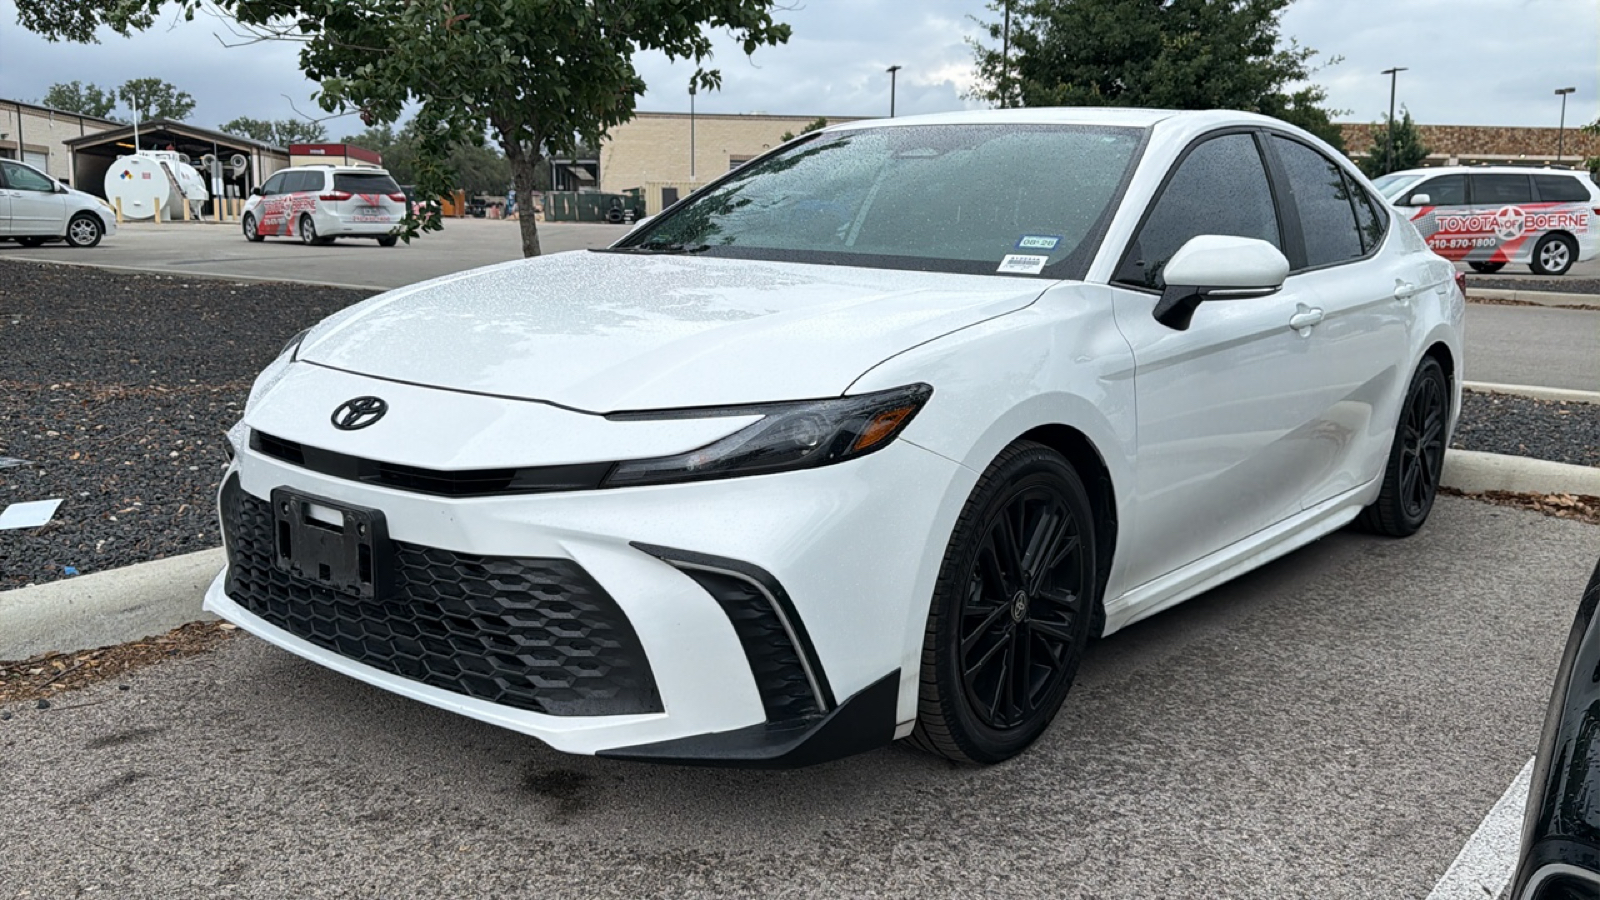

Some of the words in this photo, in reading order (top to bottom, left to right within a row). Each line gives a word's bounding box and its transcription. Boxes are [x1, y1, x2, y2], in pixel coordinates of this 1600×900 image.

[1436, 216, 1500, 231] TOYOTA
[1503, 219, 1518, 229] OF
[1524, 214, 1589, 227] BOERNE
[1428, 238, 1496, 249] 210-870-1800
